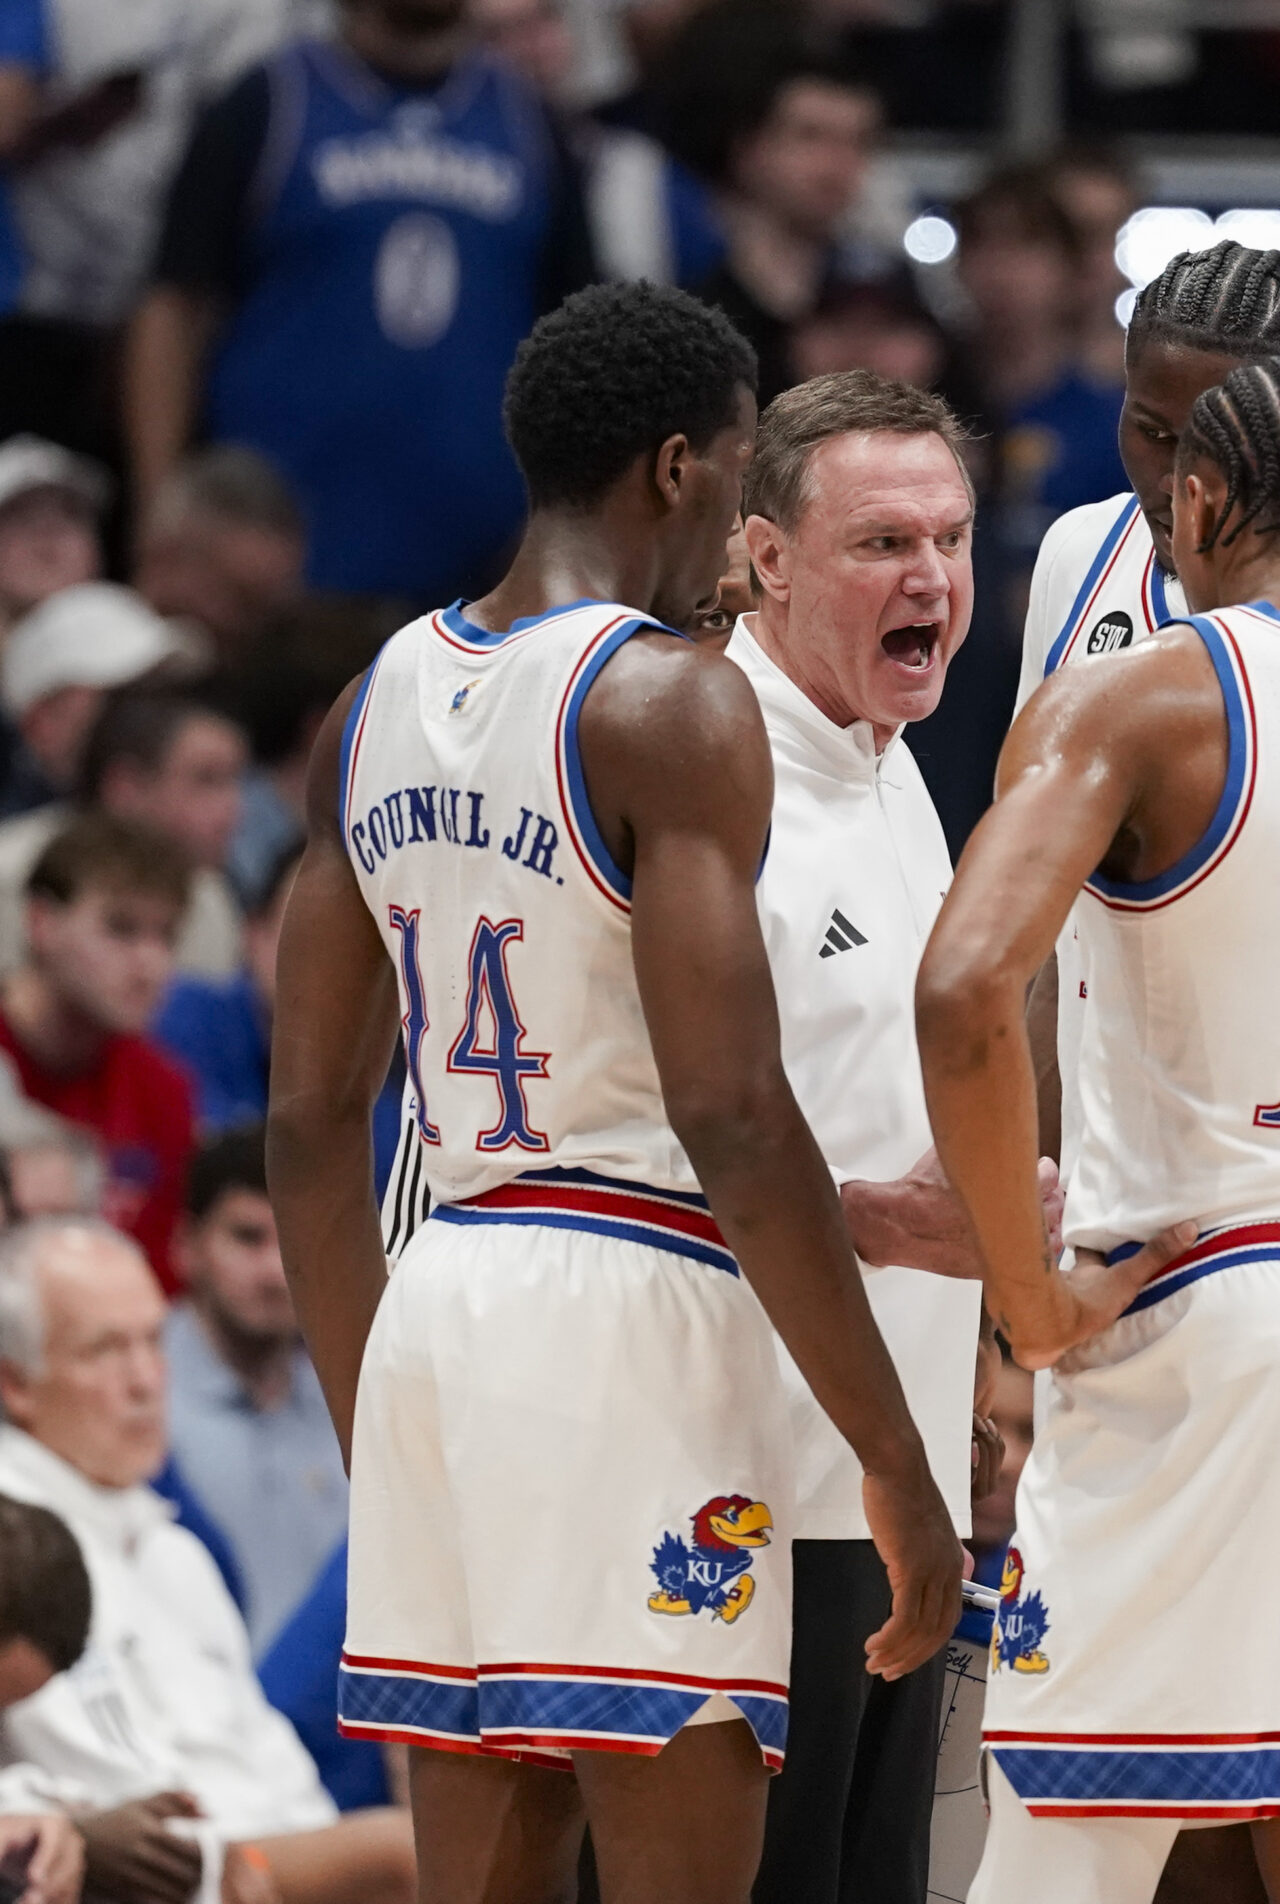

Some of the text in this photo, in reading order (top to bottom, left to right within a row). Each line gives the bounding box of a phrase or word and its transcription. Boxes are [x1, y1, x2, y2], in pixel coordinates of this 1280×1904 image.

[352, 785, 564, 886] COUNCIL JR.
[388, 904, 552, 1152] 14
[686, 1560, 723, 1587] KU
